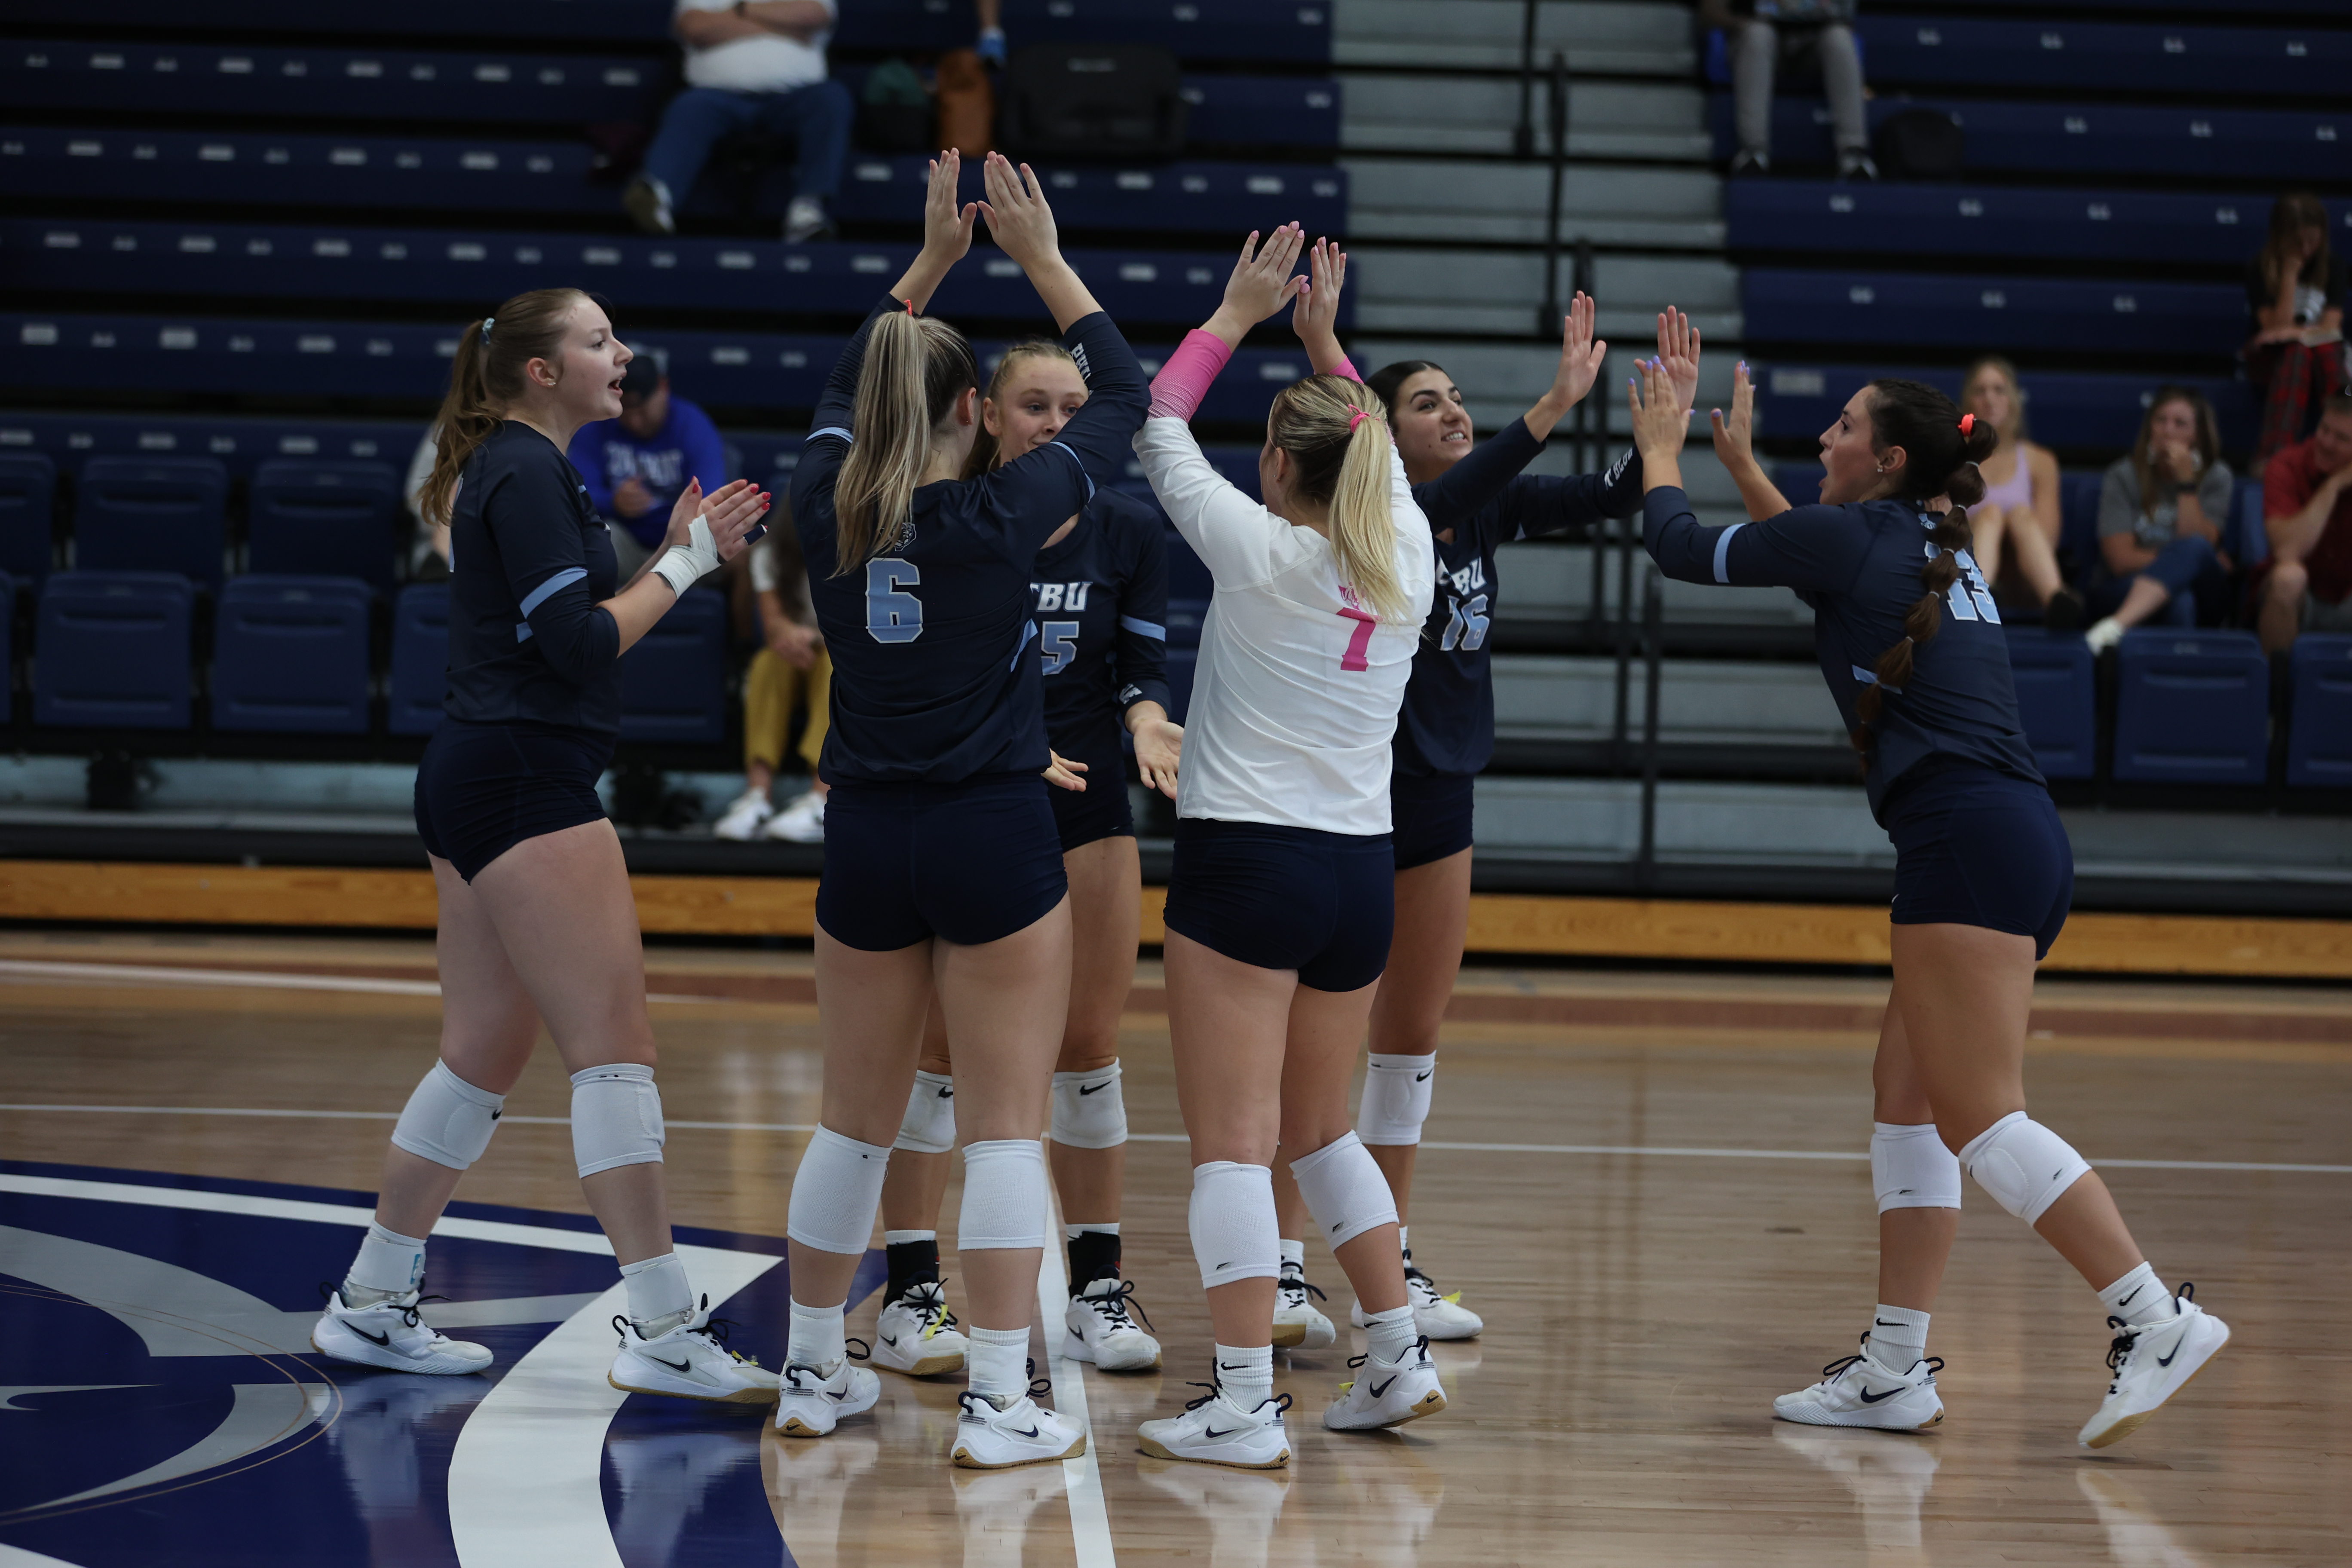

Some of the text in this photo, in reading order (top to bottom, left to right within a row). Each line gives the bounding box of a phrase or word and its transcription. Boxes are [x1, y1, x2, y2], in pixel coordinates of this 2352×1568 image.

[865, 557, 923, 643] 6
[1029, 581, 1093, 612] BU
[1439, 593, 1490, 651] 16
[1040, 621, 1080, 677] 5
[1335, 607, 1383, 672] 7
